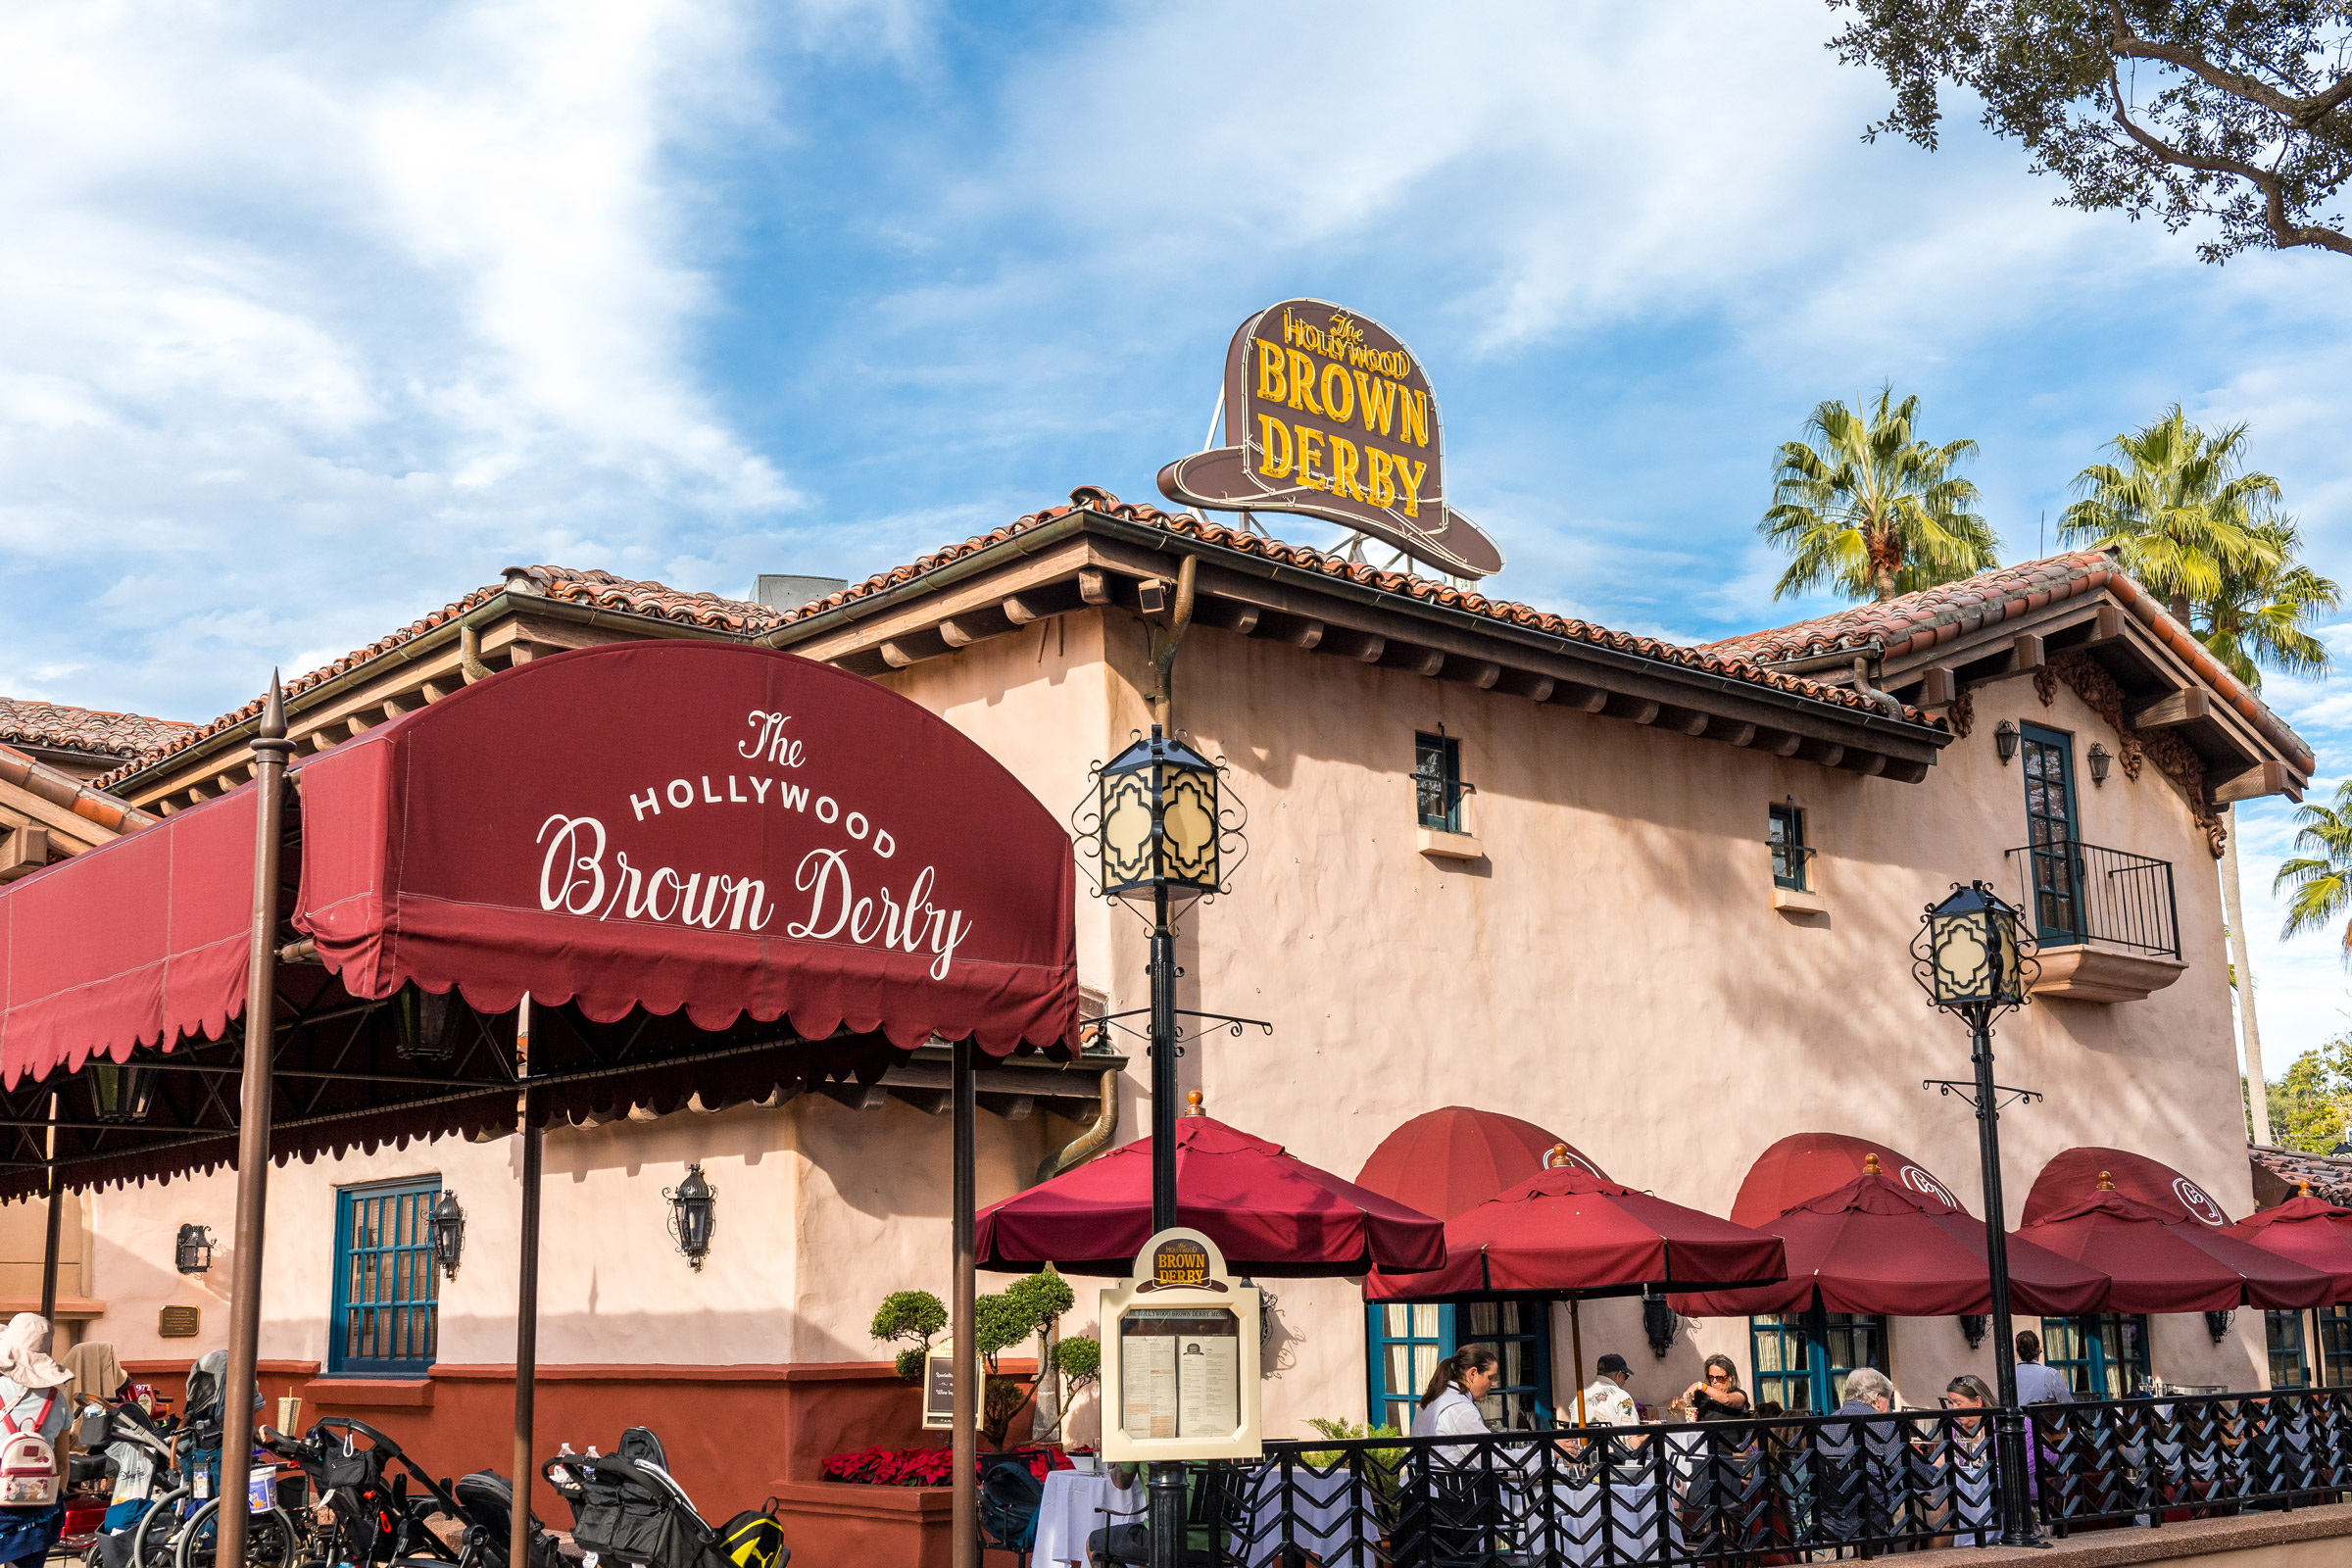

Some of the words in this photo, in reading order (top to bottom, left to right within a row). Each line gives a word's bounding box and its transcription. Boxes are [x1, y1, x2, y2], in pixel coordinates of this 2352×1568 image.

[1328, 313, 1365, 345] The
[1256, 337, 1429, 448] BROWN
[1257, 413, 1427, 517] DERBY
[738, 710, 806, 768] The
[629, 775, 896, 858] HOLLYWOOD
[536, 813, 774, 931] Brown
[787, 848, 972, 981] Derby
[1158, 1254, 1204, 1268] BROWN
[1159, 1270, 1203, 1284] DERBY
